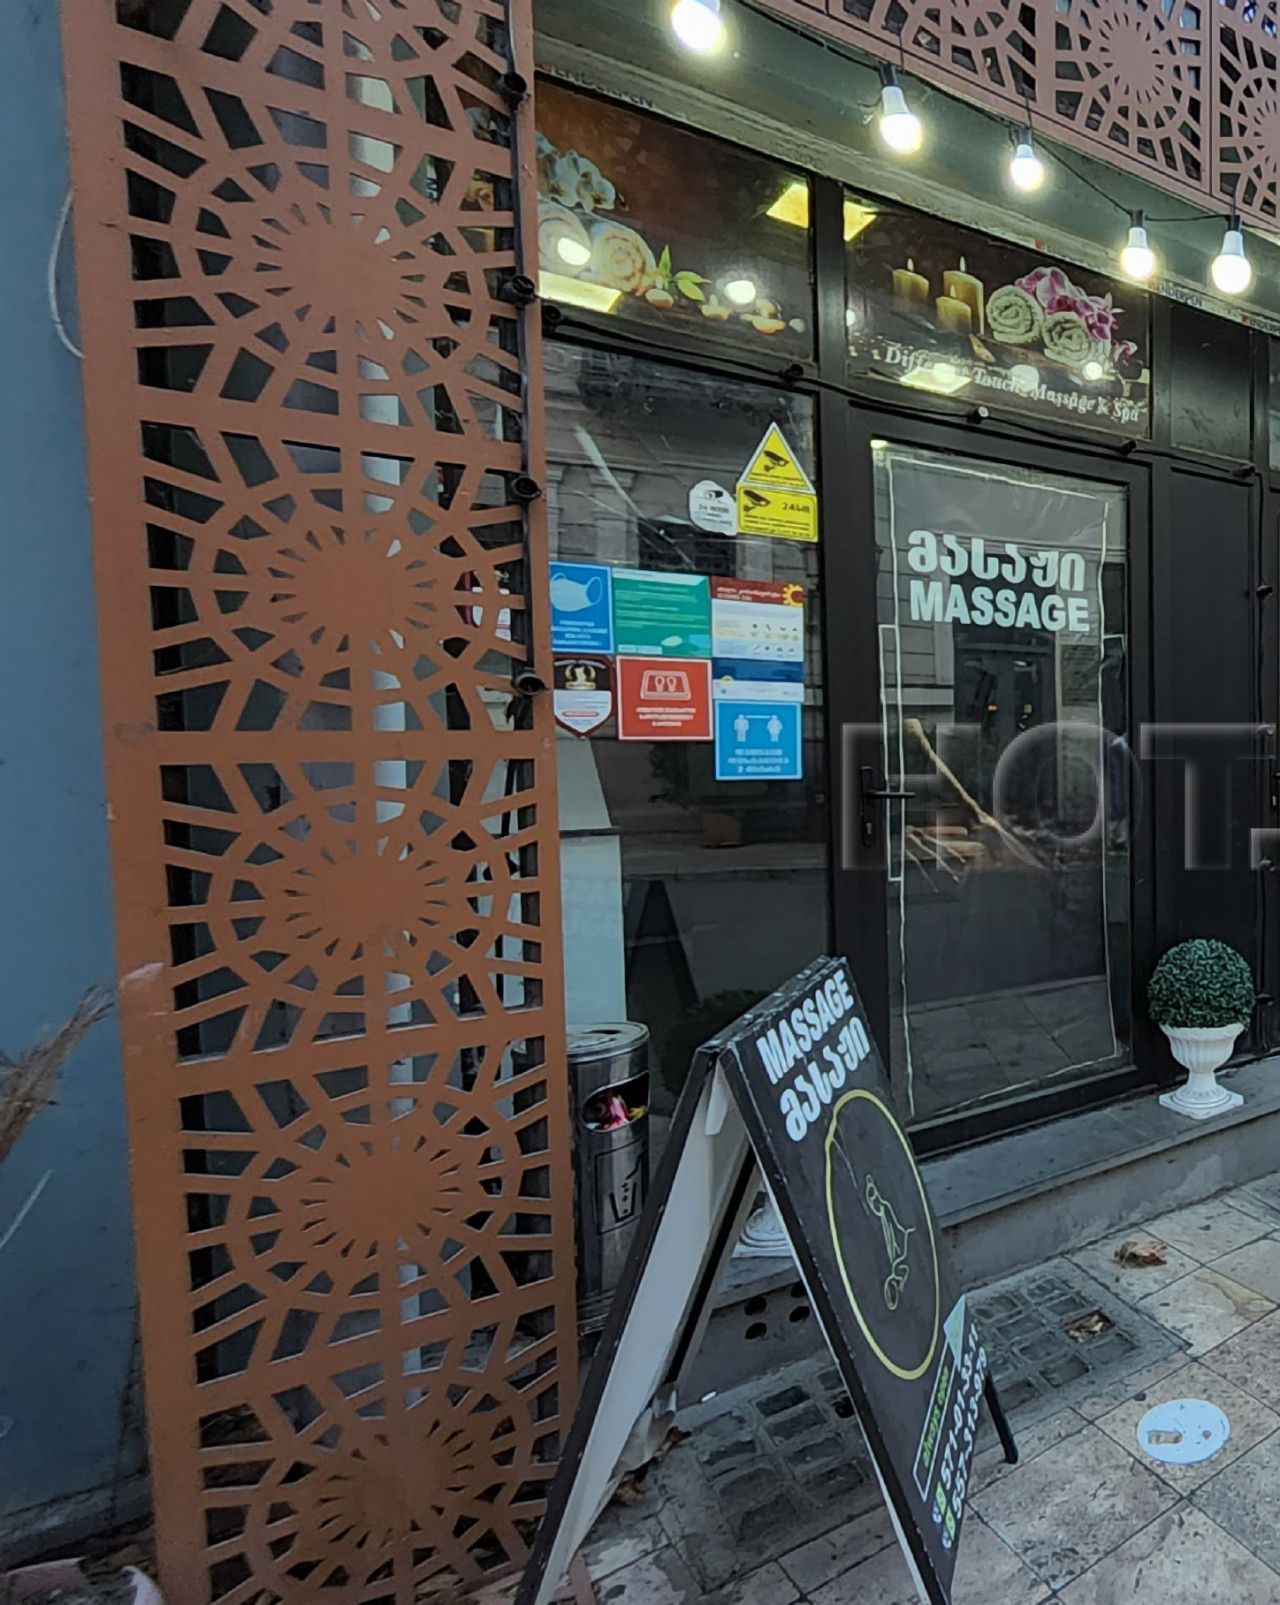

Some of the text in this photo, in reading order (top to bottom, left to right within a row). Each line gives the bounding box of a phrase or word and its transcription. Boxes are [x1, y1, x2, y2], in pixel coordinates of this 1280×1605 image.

[884, 345, 971, 377] Diffent
[907, 529, 1086, 592] მასაჟი
[909, 579, 1090, 632] MASSAGE
[756, 969, 854, 1085] MASSAGE
[780, 1016, 871, 1142] მასაჟი
